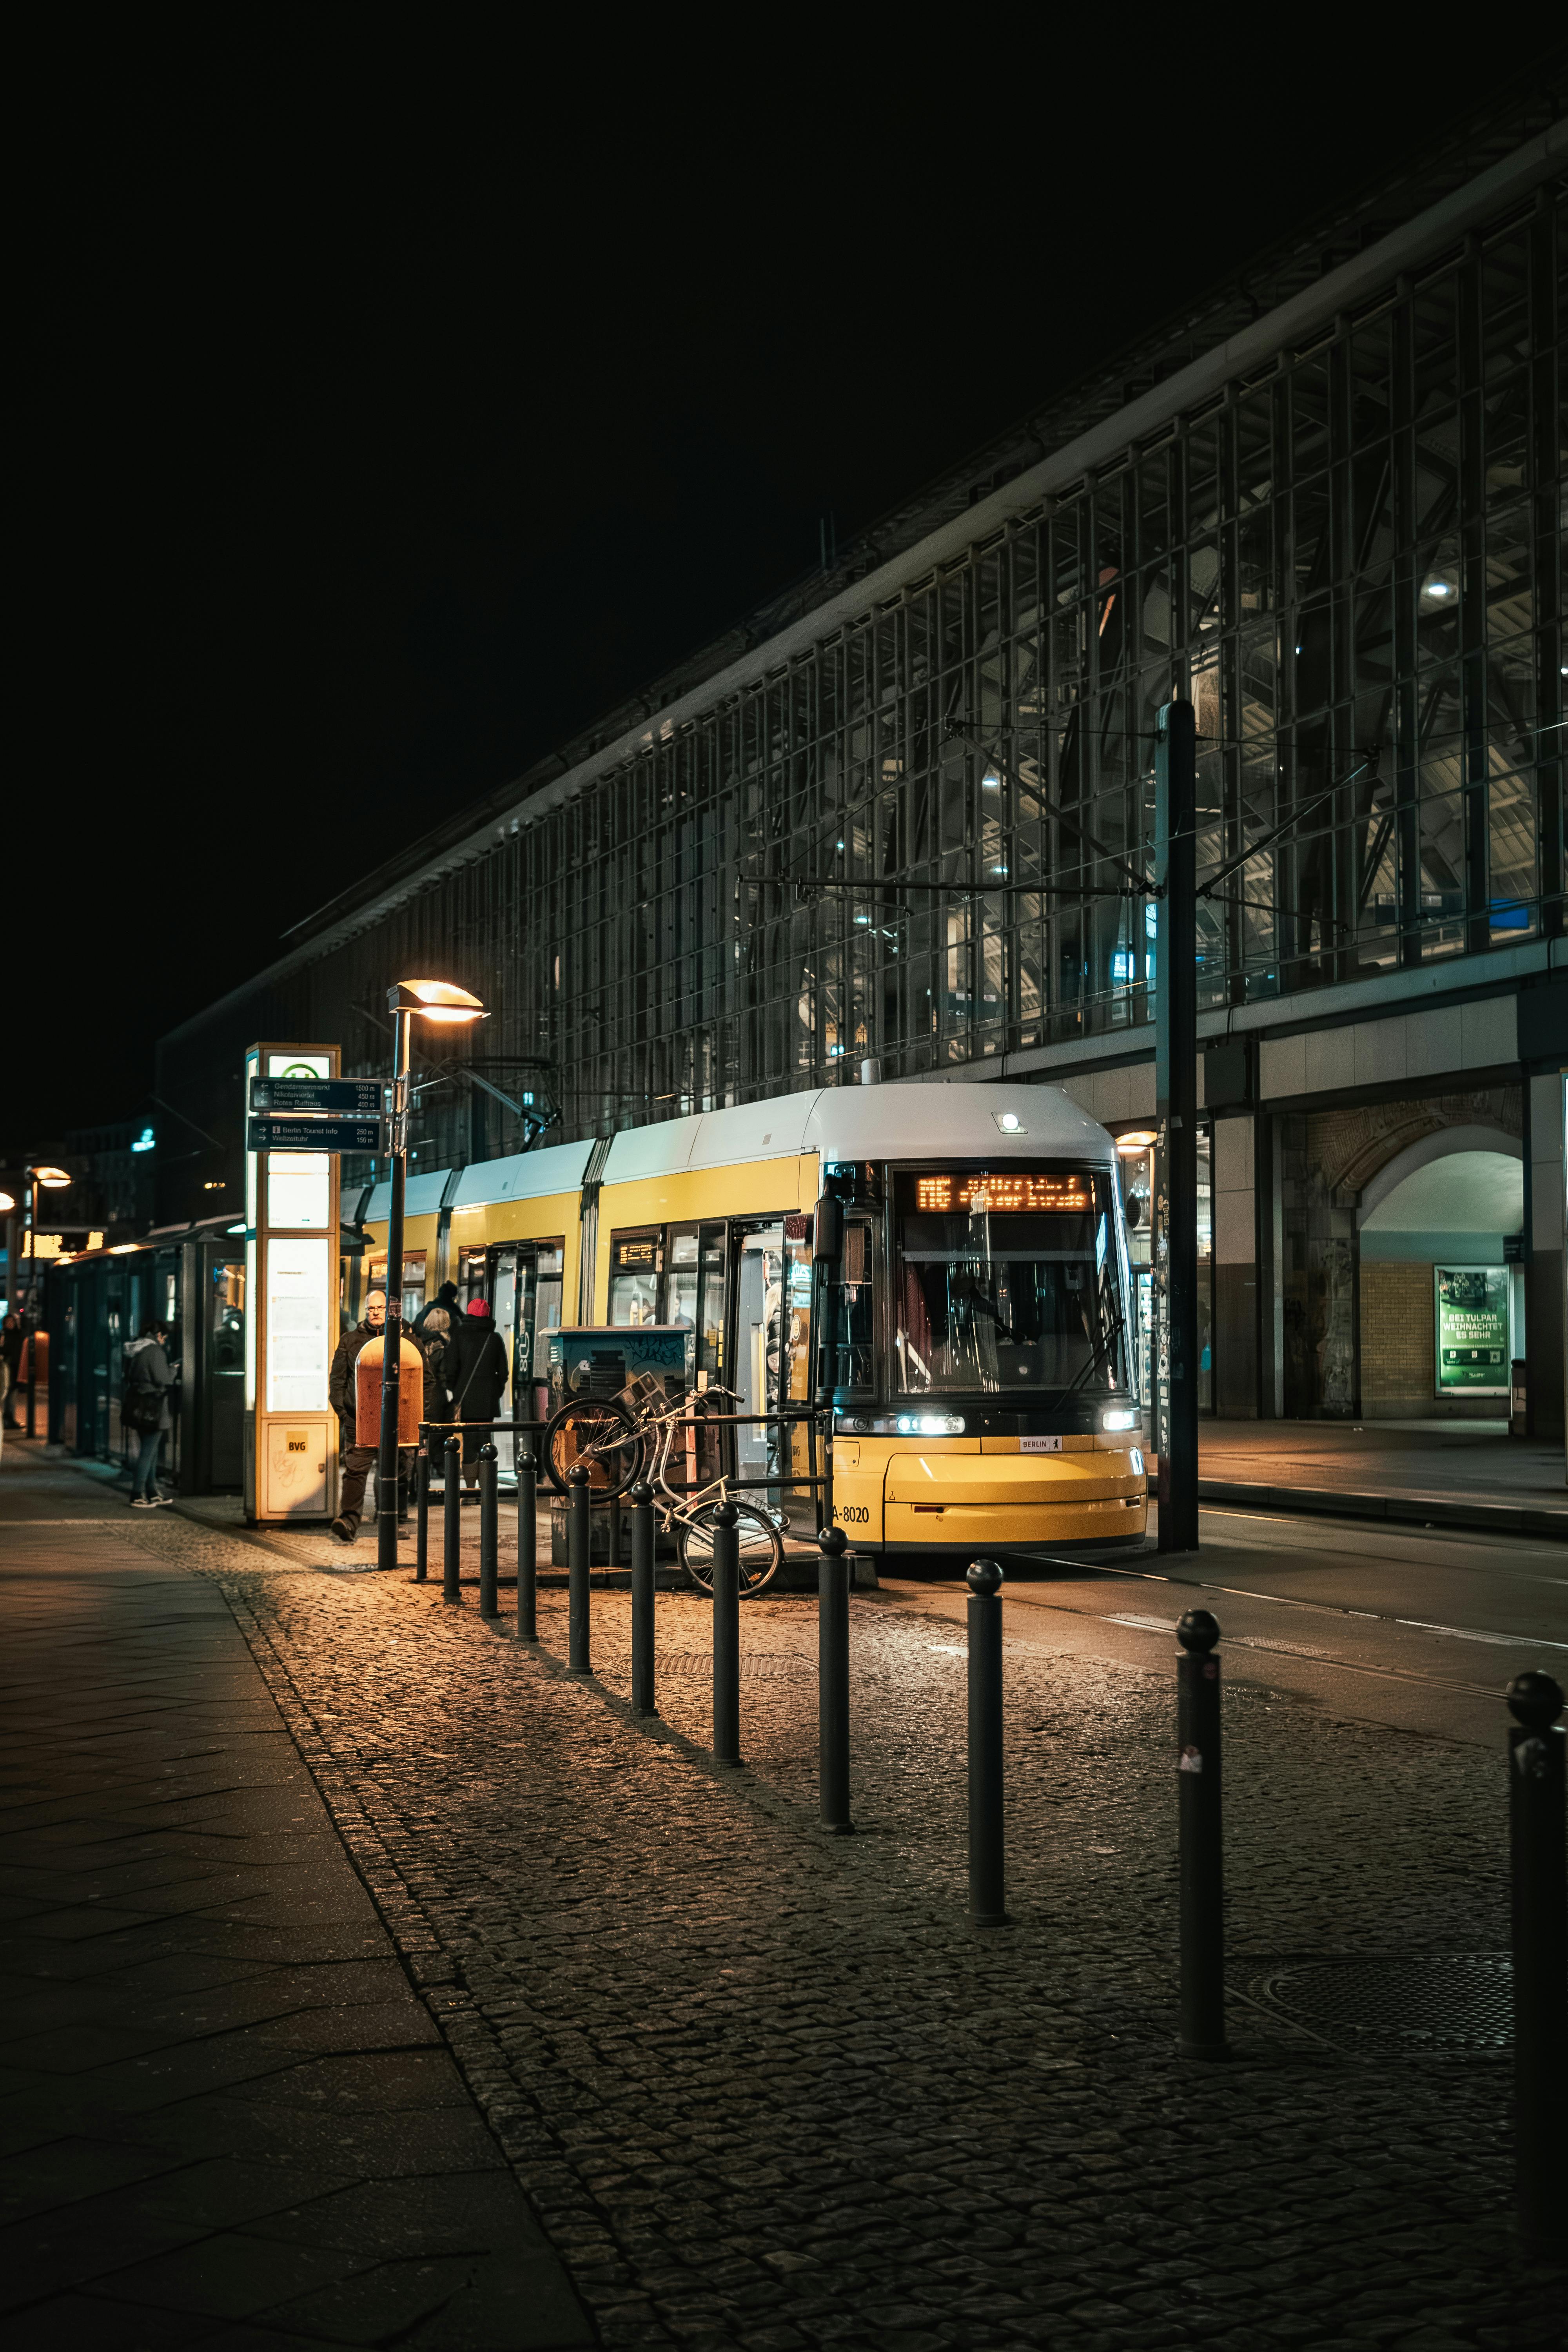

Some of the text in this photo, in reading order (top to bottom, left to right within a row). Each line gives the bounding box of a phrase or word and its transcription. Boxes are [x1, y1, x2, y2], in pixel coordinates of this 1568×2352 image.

[1443, 1322, 1503, 1330] WEIHNACHTET
[1456, 1331, 1490, 1339] ES SEHR
[289, 1442, 305, 1450] BVG
